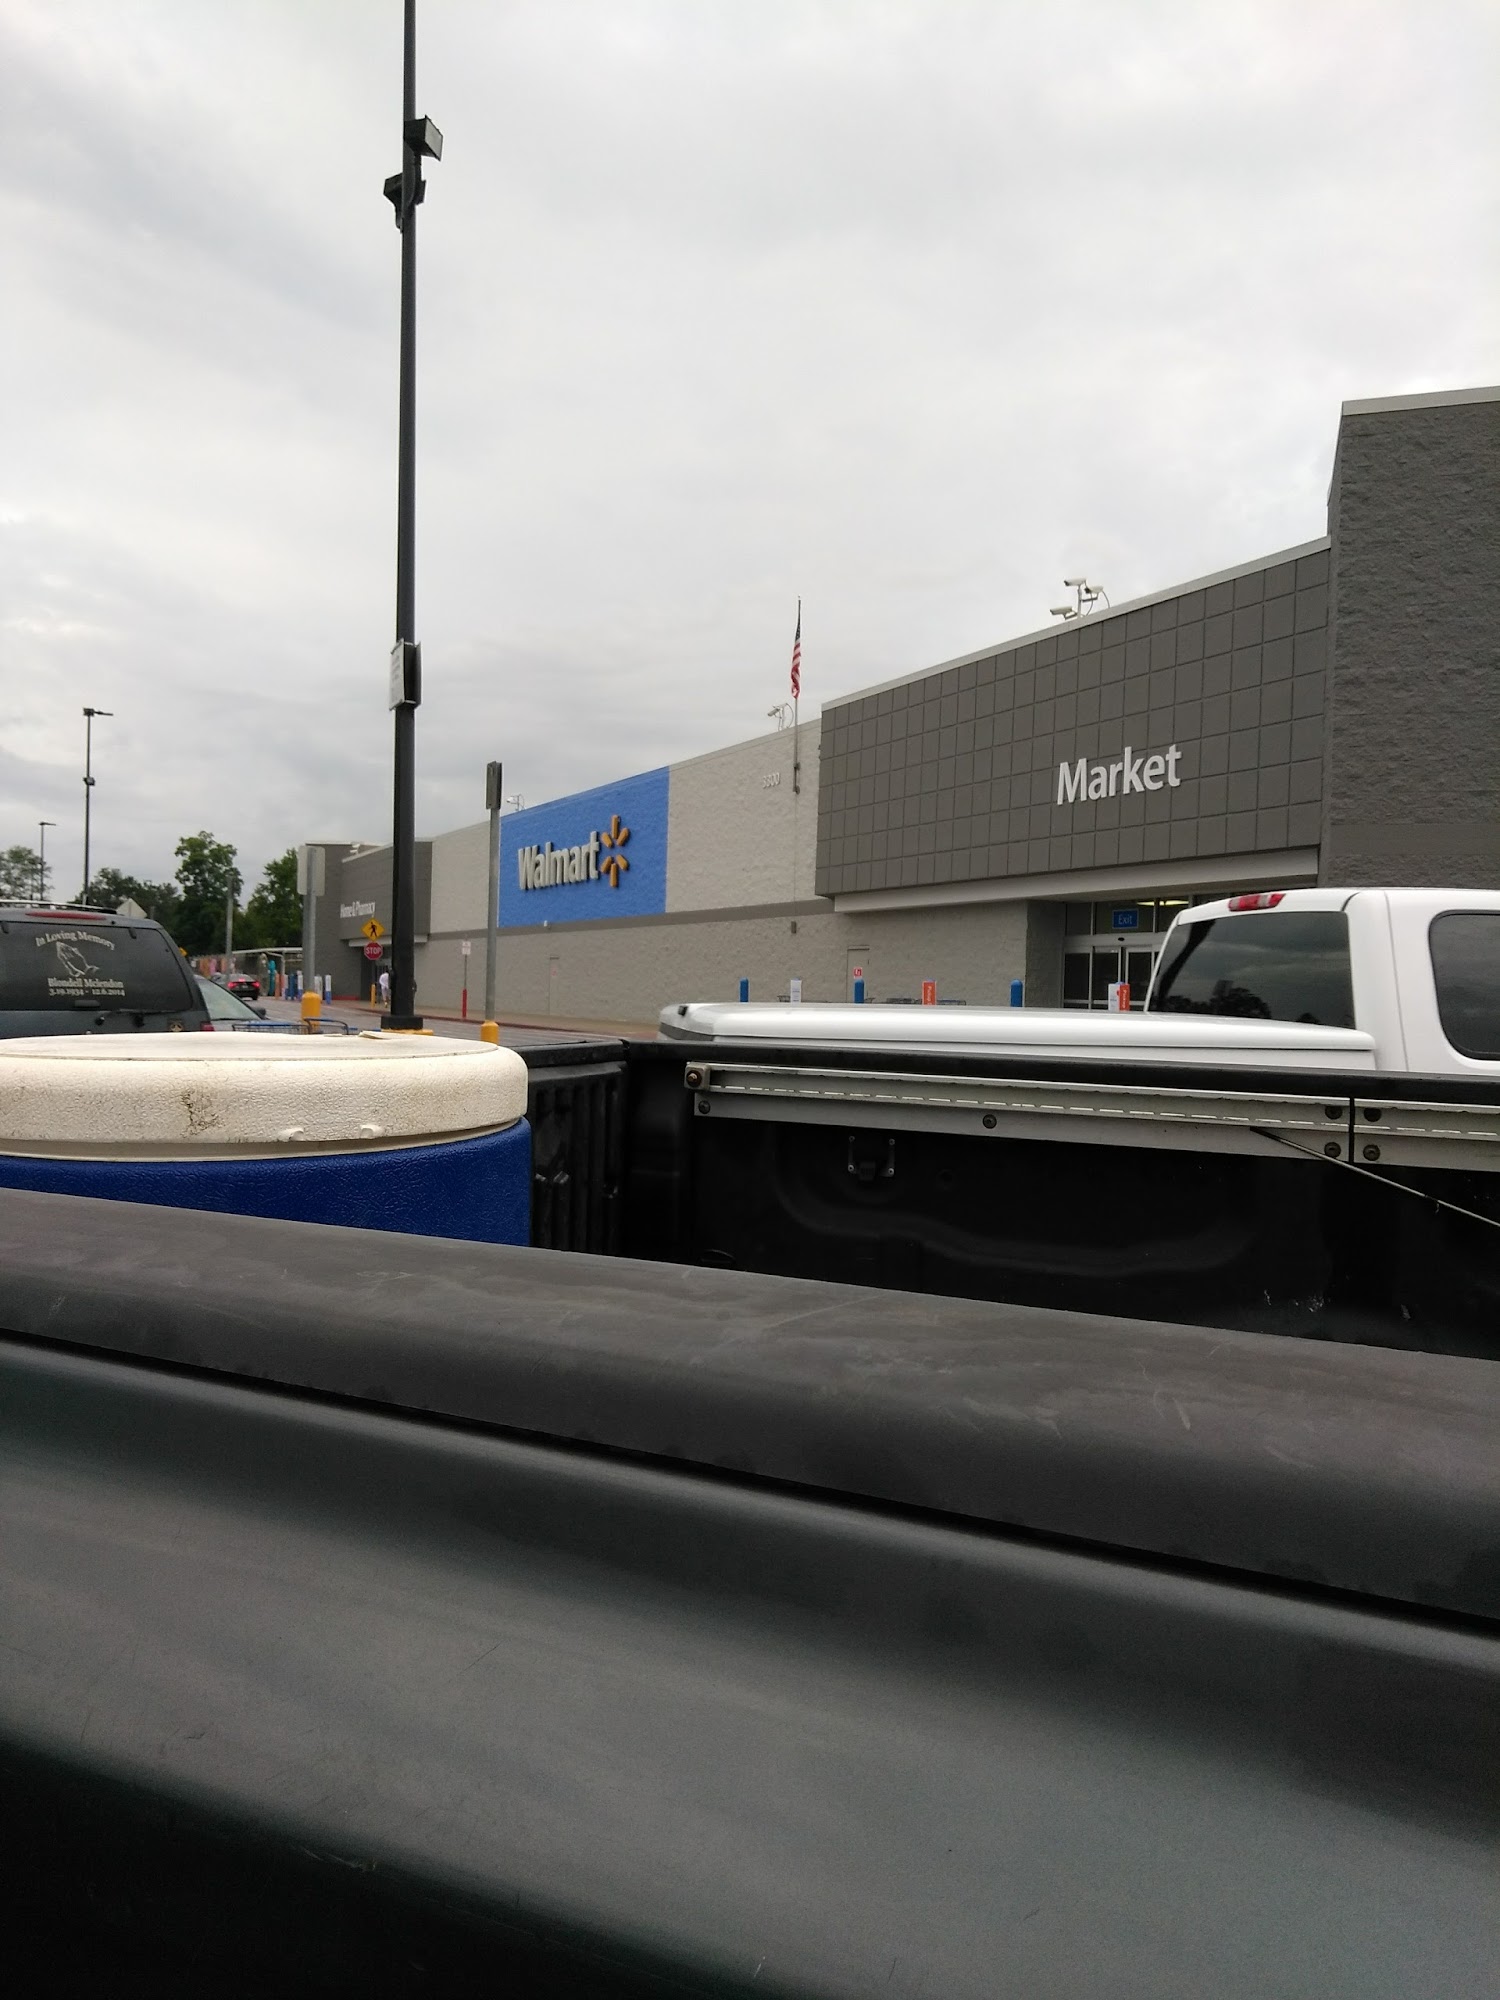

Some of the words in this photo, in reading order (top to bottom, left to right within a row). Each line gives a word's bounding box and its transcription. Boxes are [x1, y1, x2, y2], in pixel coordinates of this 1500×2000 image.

[1057, 744, 1182, 806] Market
[518, 830, 600, 890] Walmart
[1118, 914, 1133, 925] Exit
[36, 937, 46, 947] In
[45, 931, 78, 941] Loving
[77, 931, 115, 951] Memory
